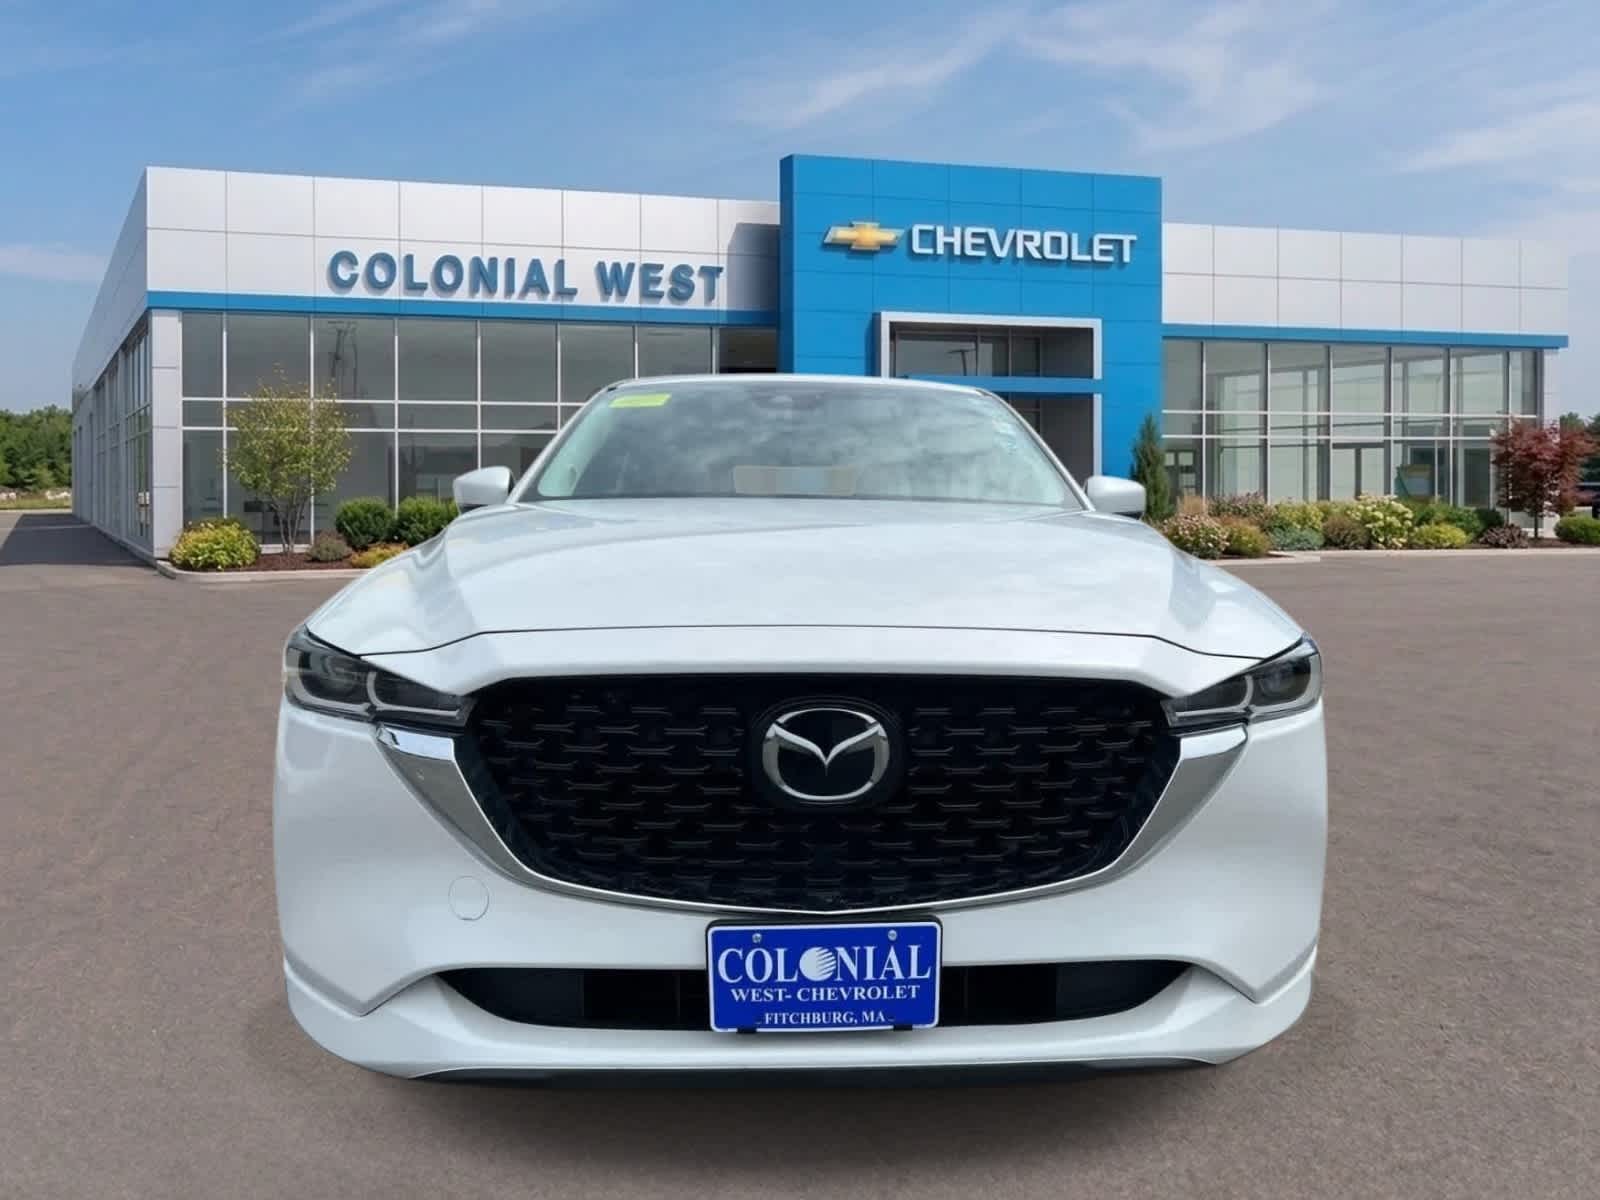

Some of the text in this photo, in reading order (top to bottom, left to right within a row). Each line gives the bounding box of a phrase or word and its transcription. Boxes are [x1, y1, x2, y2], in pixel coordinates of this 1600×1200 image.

[911, 223, 1137, 263] CHEVROLET
[327, 250, 724, 303] COLONIAL WEST
[717, 944, 932, 984] COLONIAL
[797, 985, 920, 1001] CHEVROLET
[765, 1010, 885, 1025] FITCHBURG, MA
